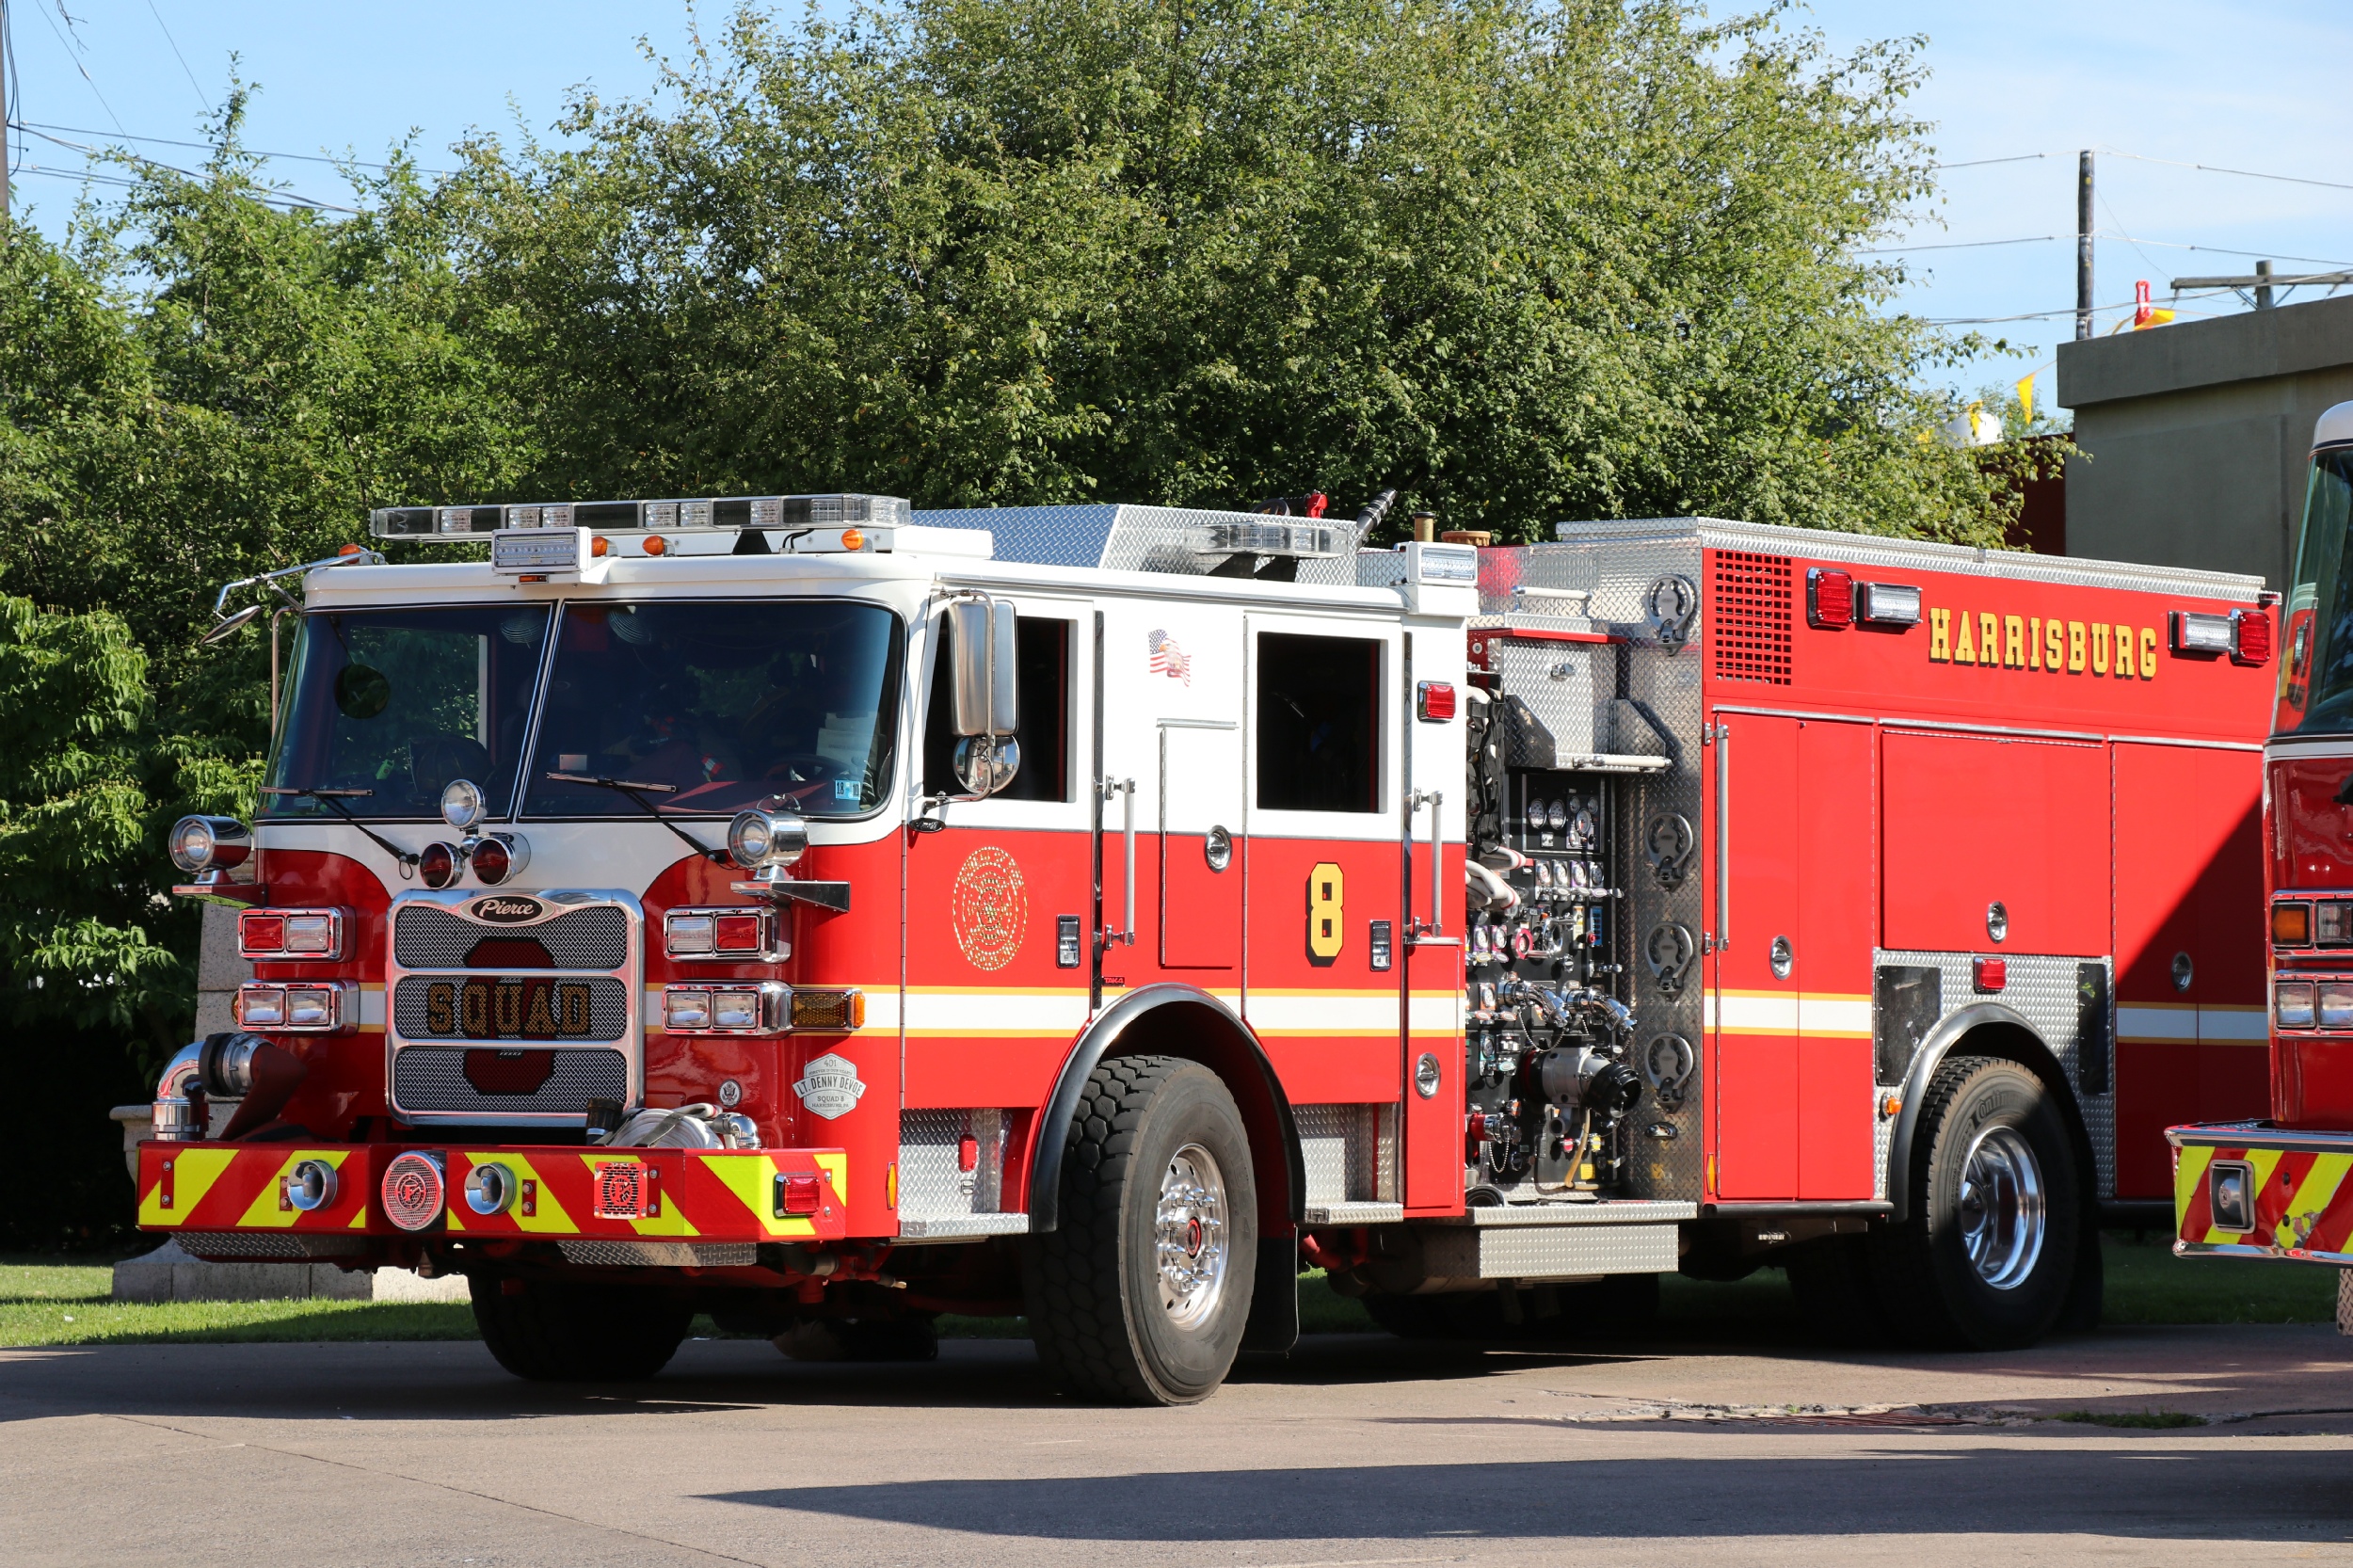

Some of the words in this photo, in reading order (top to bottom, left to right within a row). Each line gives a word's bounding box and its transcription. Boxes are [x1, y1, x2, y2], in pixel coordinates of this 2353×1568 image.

[1928, 607, 2157, 680] HARRISBURG
[837, 782, 844, 795] 18
[478, 899, 535, 918] Pierce
[1305, 861, 1344, 967] 8
[427, 984, 591, 1035] SQUAD
[824, 1059, 837, 1067] 401
[797, 1080, 810, 1095] LT.
[810, 1075, 838, 1090] DENNY
[840, 1076, 863, 1096] DEVOE
